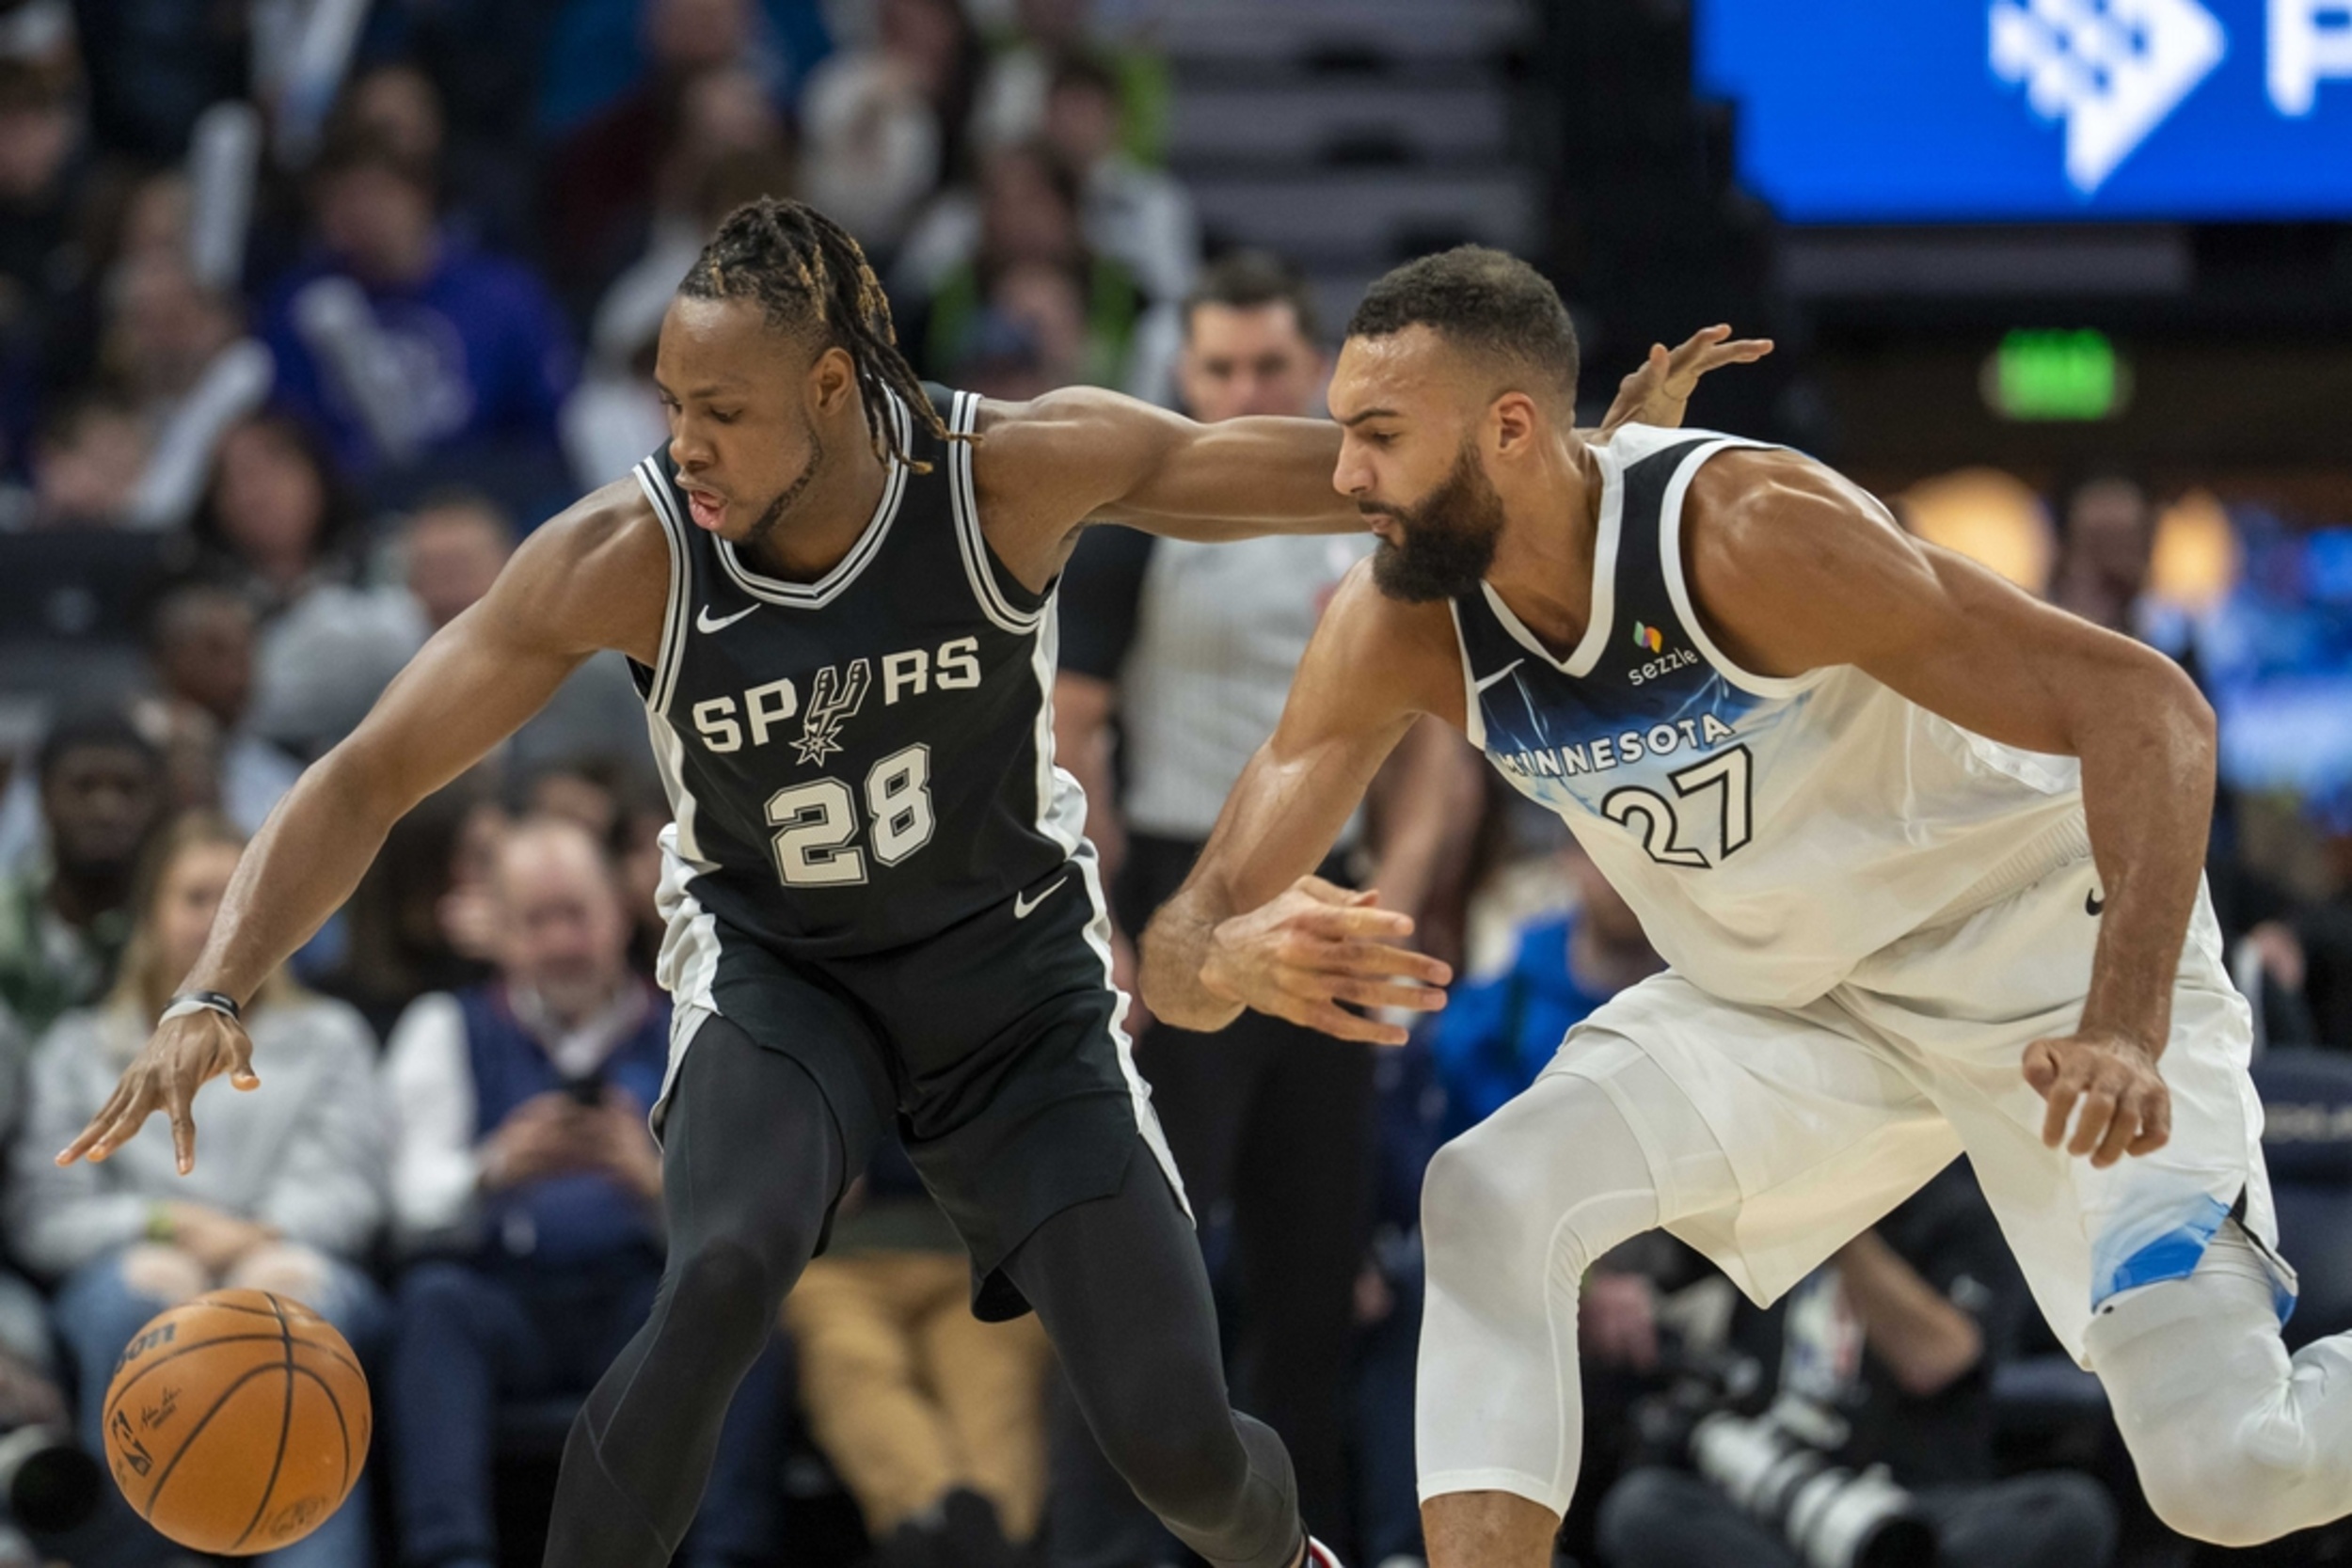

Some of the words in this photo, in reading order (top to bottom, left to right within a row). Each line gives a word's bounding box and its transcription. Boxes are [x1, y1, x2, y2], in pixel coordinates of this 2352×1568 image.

[692, 636, 980, 767] SPURS
[1628, 646, 1699, 687] sezzle
[763, 741, 936, 888] 28
[1599, 741, 1753, 870] 27
